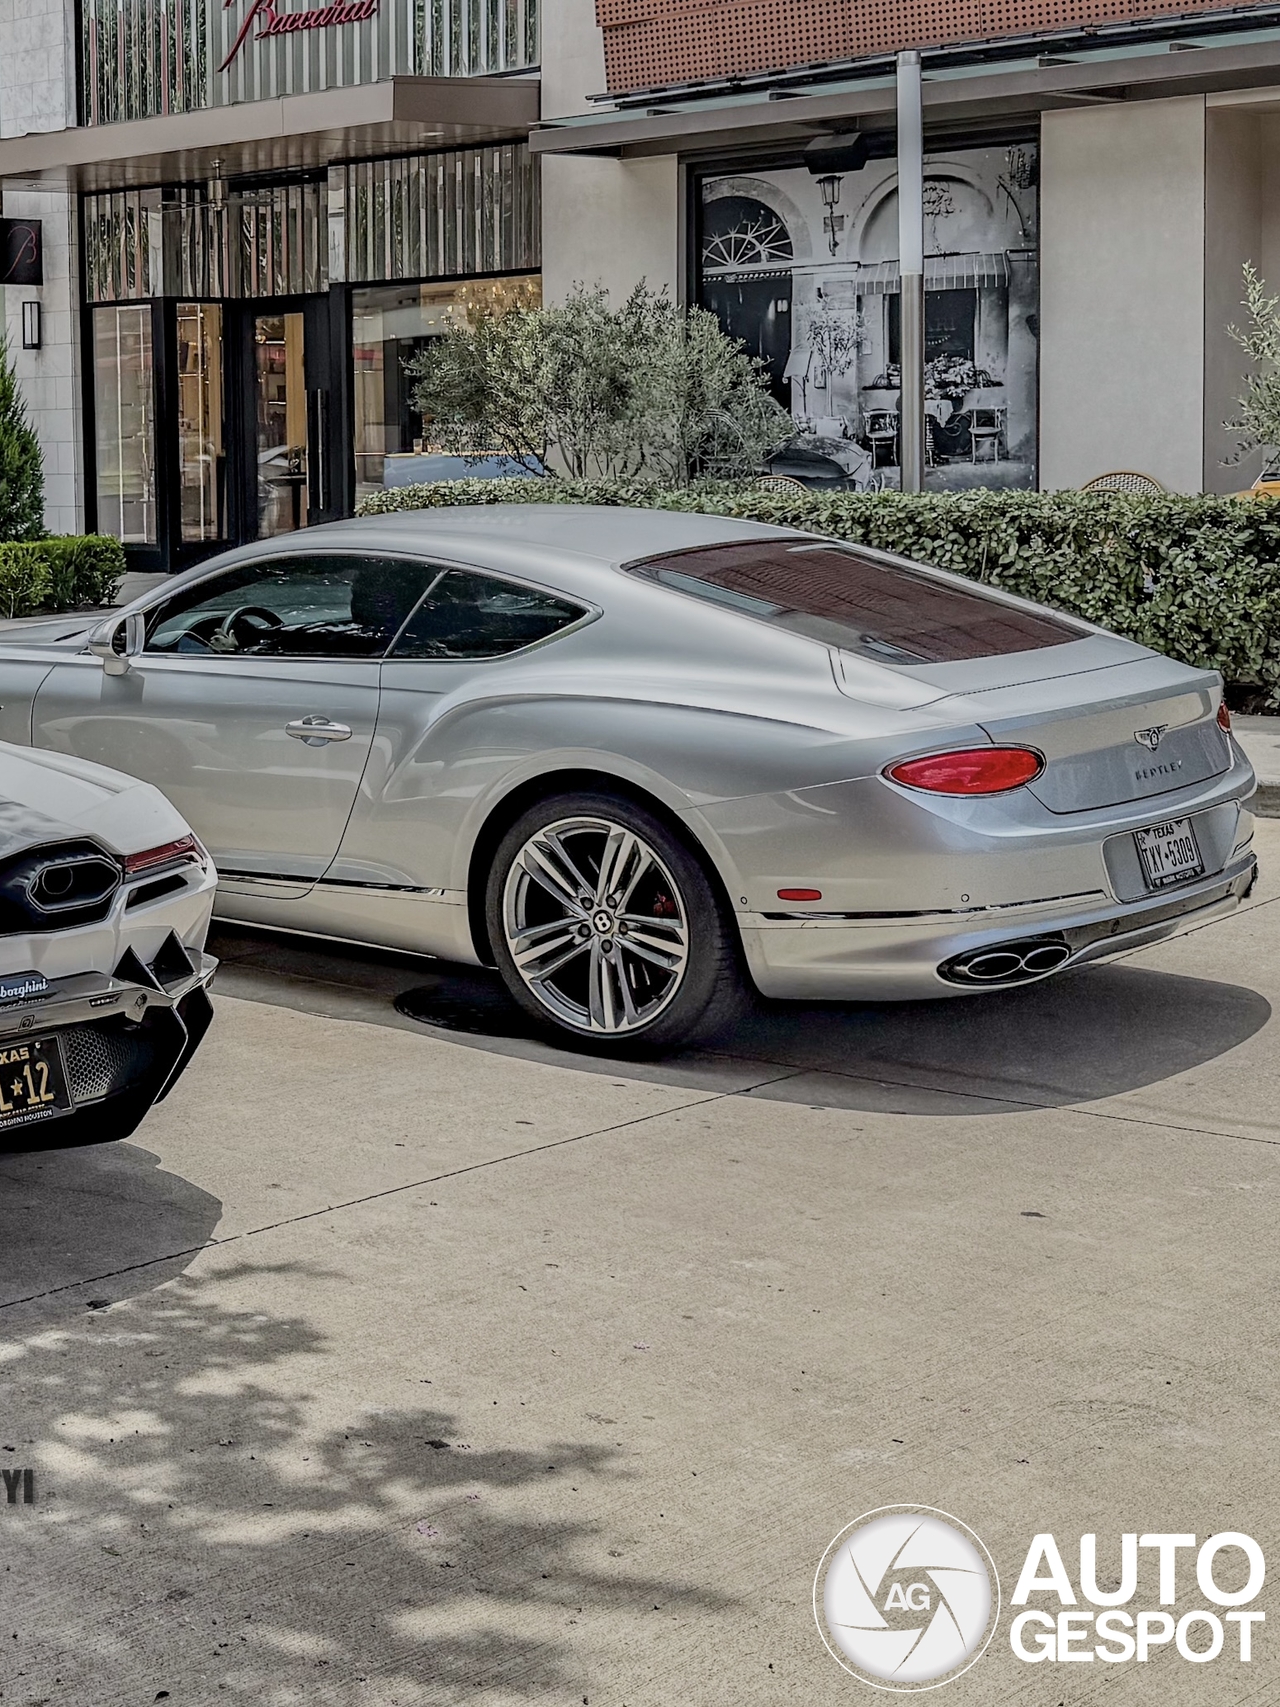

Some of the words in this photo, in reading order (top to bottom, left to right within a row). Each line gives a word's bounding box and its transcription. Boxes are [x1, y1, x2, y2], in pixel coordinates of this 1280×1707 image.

[217, 0, 376, 73] Baccarat
[1135, 760, 1183, 781] BENTLEY
[1152, 822, 1175, 840] TEXAS
[24, 1109, 53, 1122] HOUSTON
